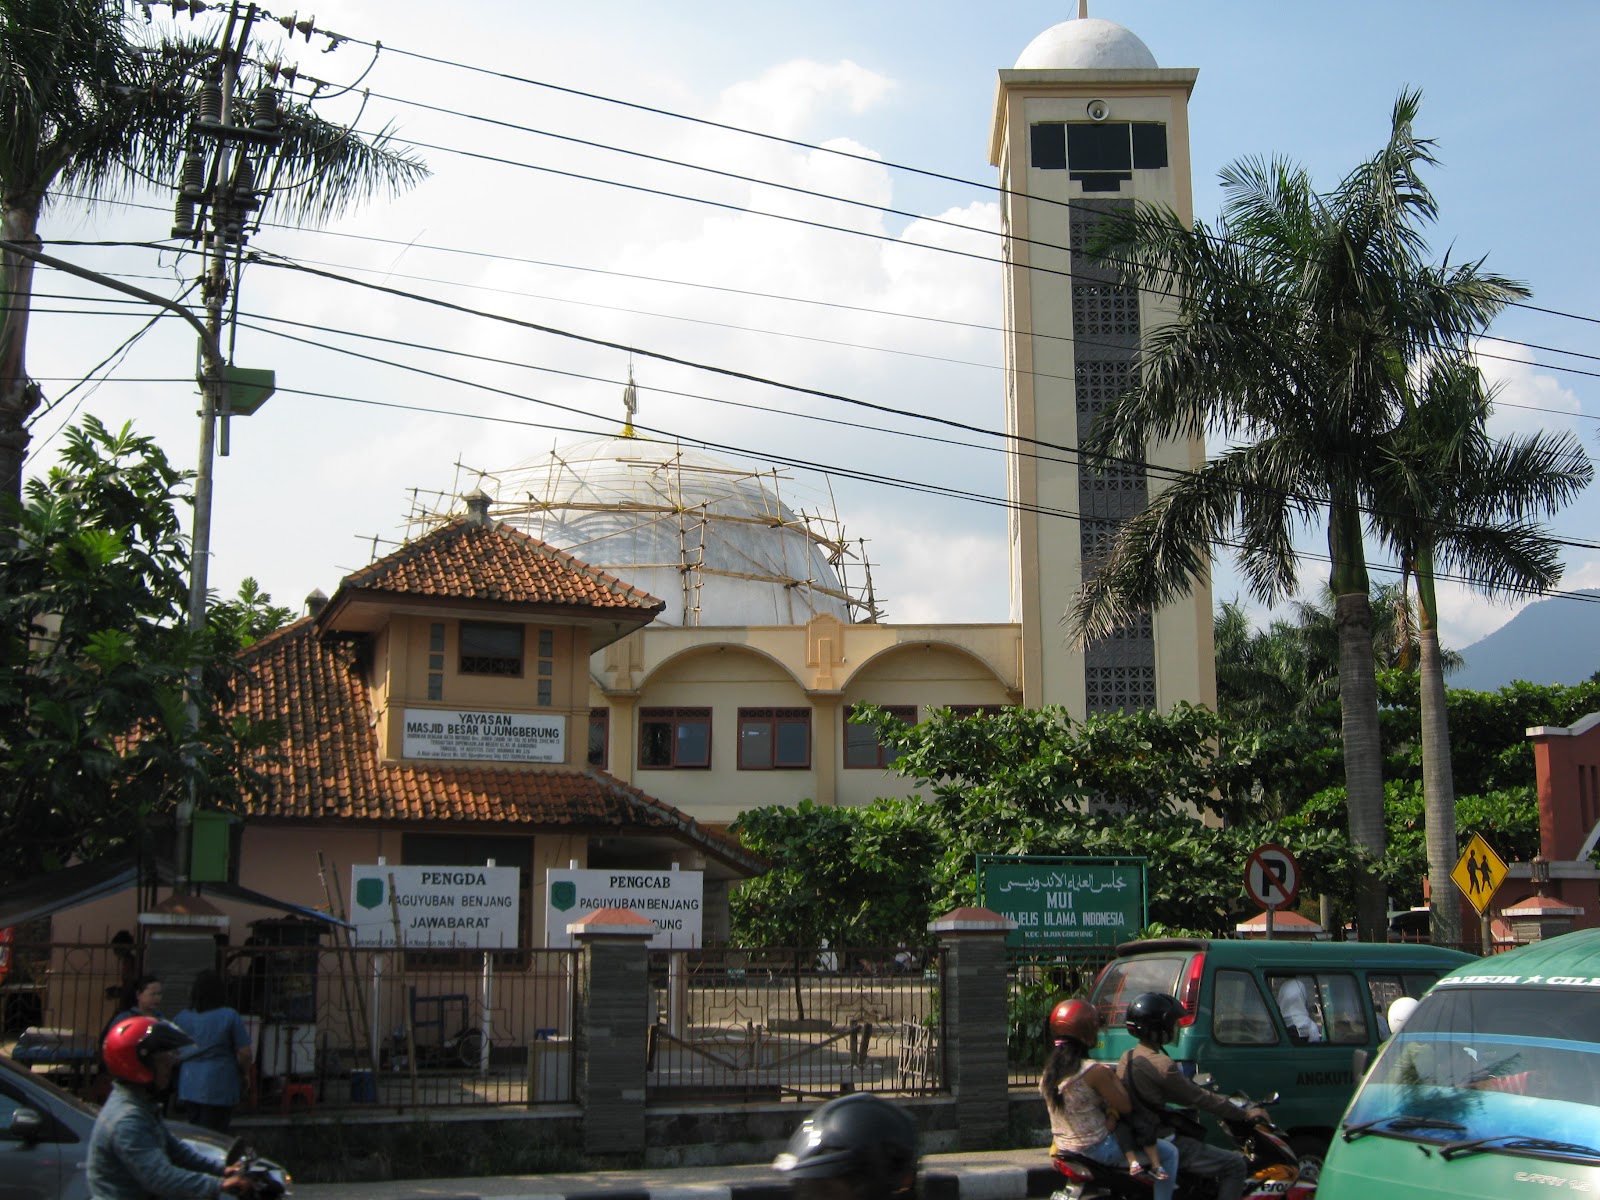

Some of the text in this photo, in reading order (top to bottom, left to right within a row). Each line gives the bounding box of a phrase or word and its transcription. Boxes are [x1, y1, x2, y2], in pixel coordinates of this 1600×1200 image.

[459, 713, 512, 726] YAYASAN
[407, 722, 444, 734] MASJID
[448, 724, 479, 736] BESAR
[483, 726, 560, 739] UJUNGBERUNG
[421, 872, 487, 886] PENGDA
[609, 876, 671, 888] PENGCAB
[461, 896, 512, 908] BENJANG
[580, 897, 699, 910] PAGUYUBAN BENJANG
[1046, 892, 1073, 909] MUI
[1044, 912, 1077, 926] ULAMA
[1083, 912, 1125, 926] INDONESIA
